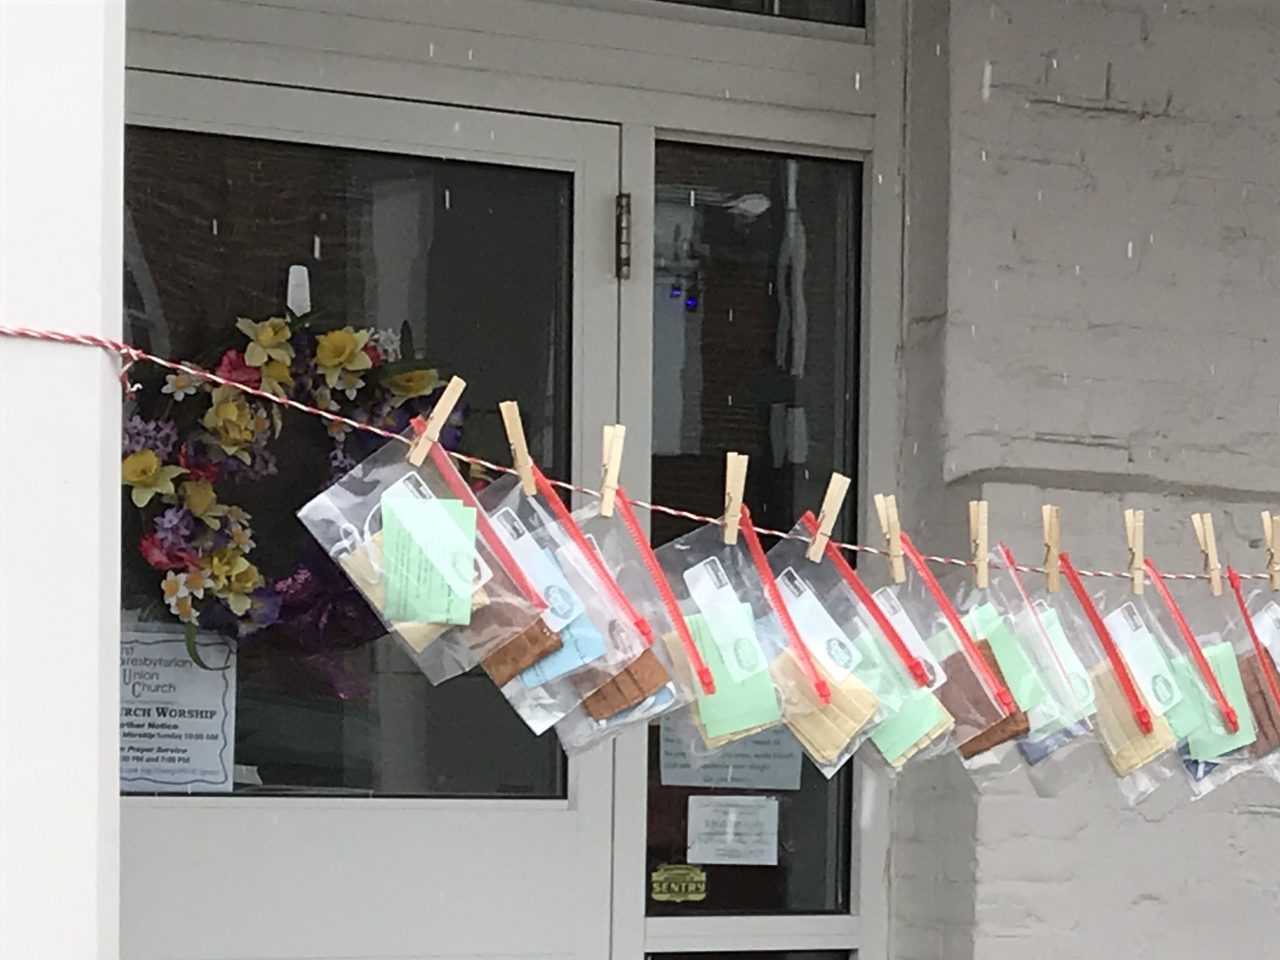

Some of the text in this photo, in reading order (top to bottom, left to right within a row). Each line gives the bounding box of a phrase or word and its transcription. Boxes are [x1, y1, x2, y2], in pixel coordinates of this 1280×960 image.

[123, 668, 160, 686] Union
[132, 681, 176, 698] Church
[652, 882, 706, 892] SENTRY
